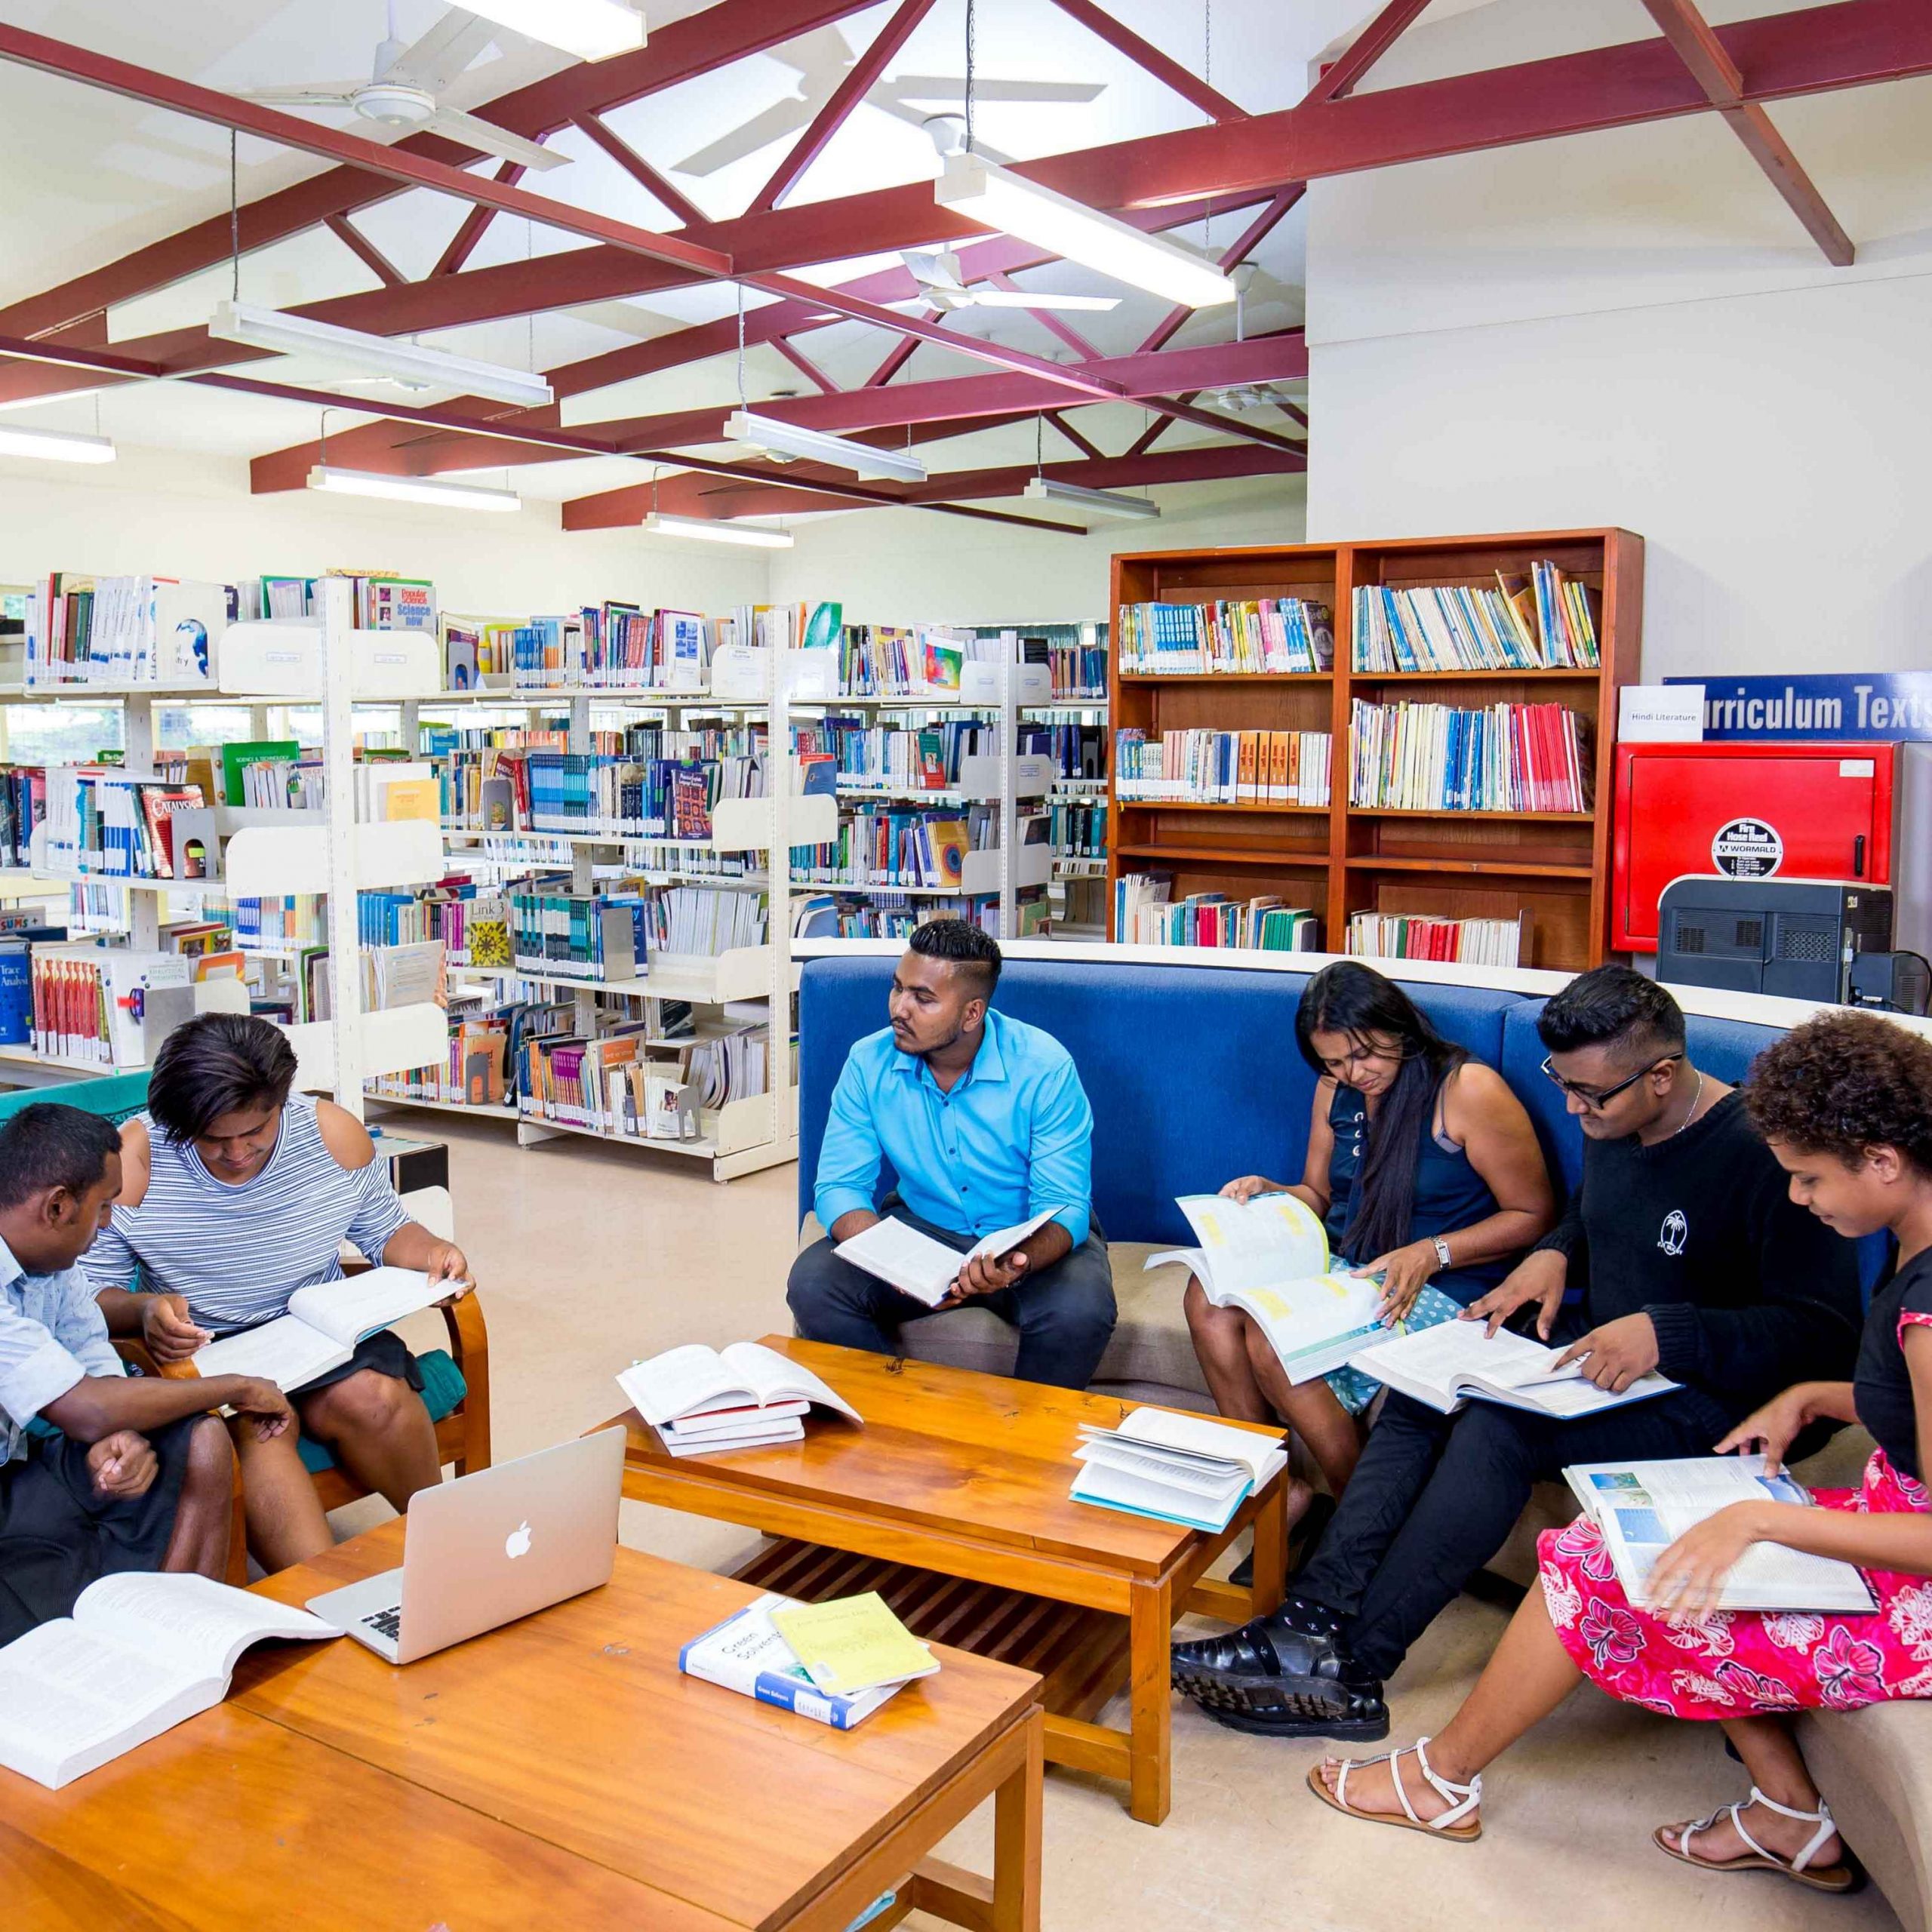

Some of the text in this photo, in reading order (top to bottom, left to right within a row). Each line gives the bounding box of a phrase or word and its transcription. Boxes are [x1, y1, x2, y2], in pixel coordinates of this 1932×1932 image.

[397, 604, 431, 616] Science
[1703, 686, 1842, 730] rriculum
[1739, 823, 1755, 832] Fire
[1727, 832, 1767, 842] Hose Reel
[1730, 845, 1776, 854] WORMALD
[472, 902, 504, 915] Link 3
[1, 918, 28, 931] SUMS
[721, 1633, 758, 1654] Green
